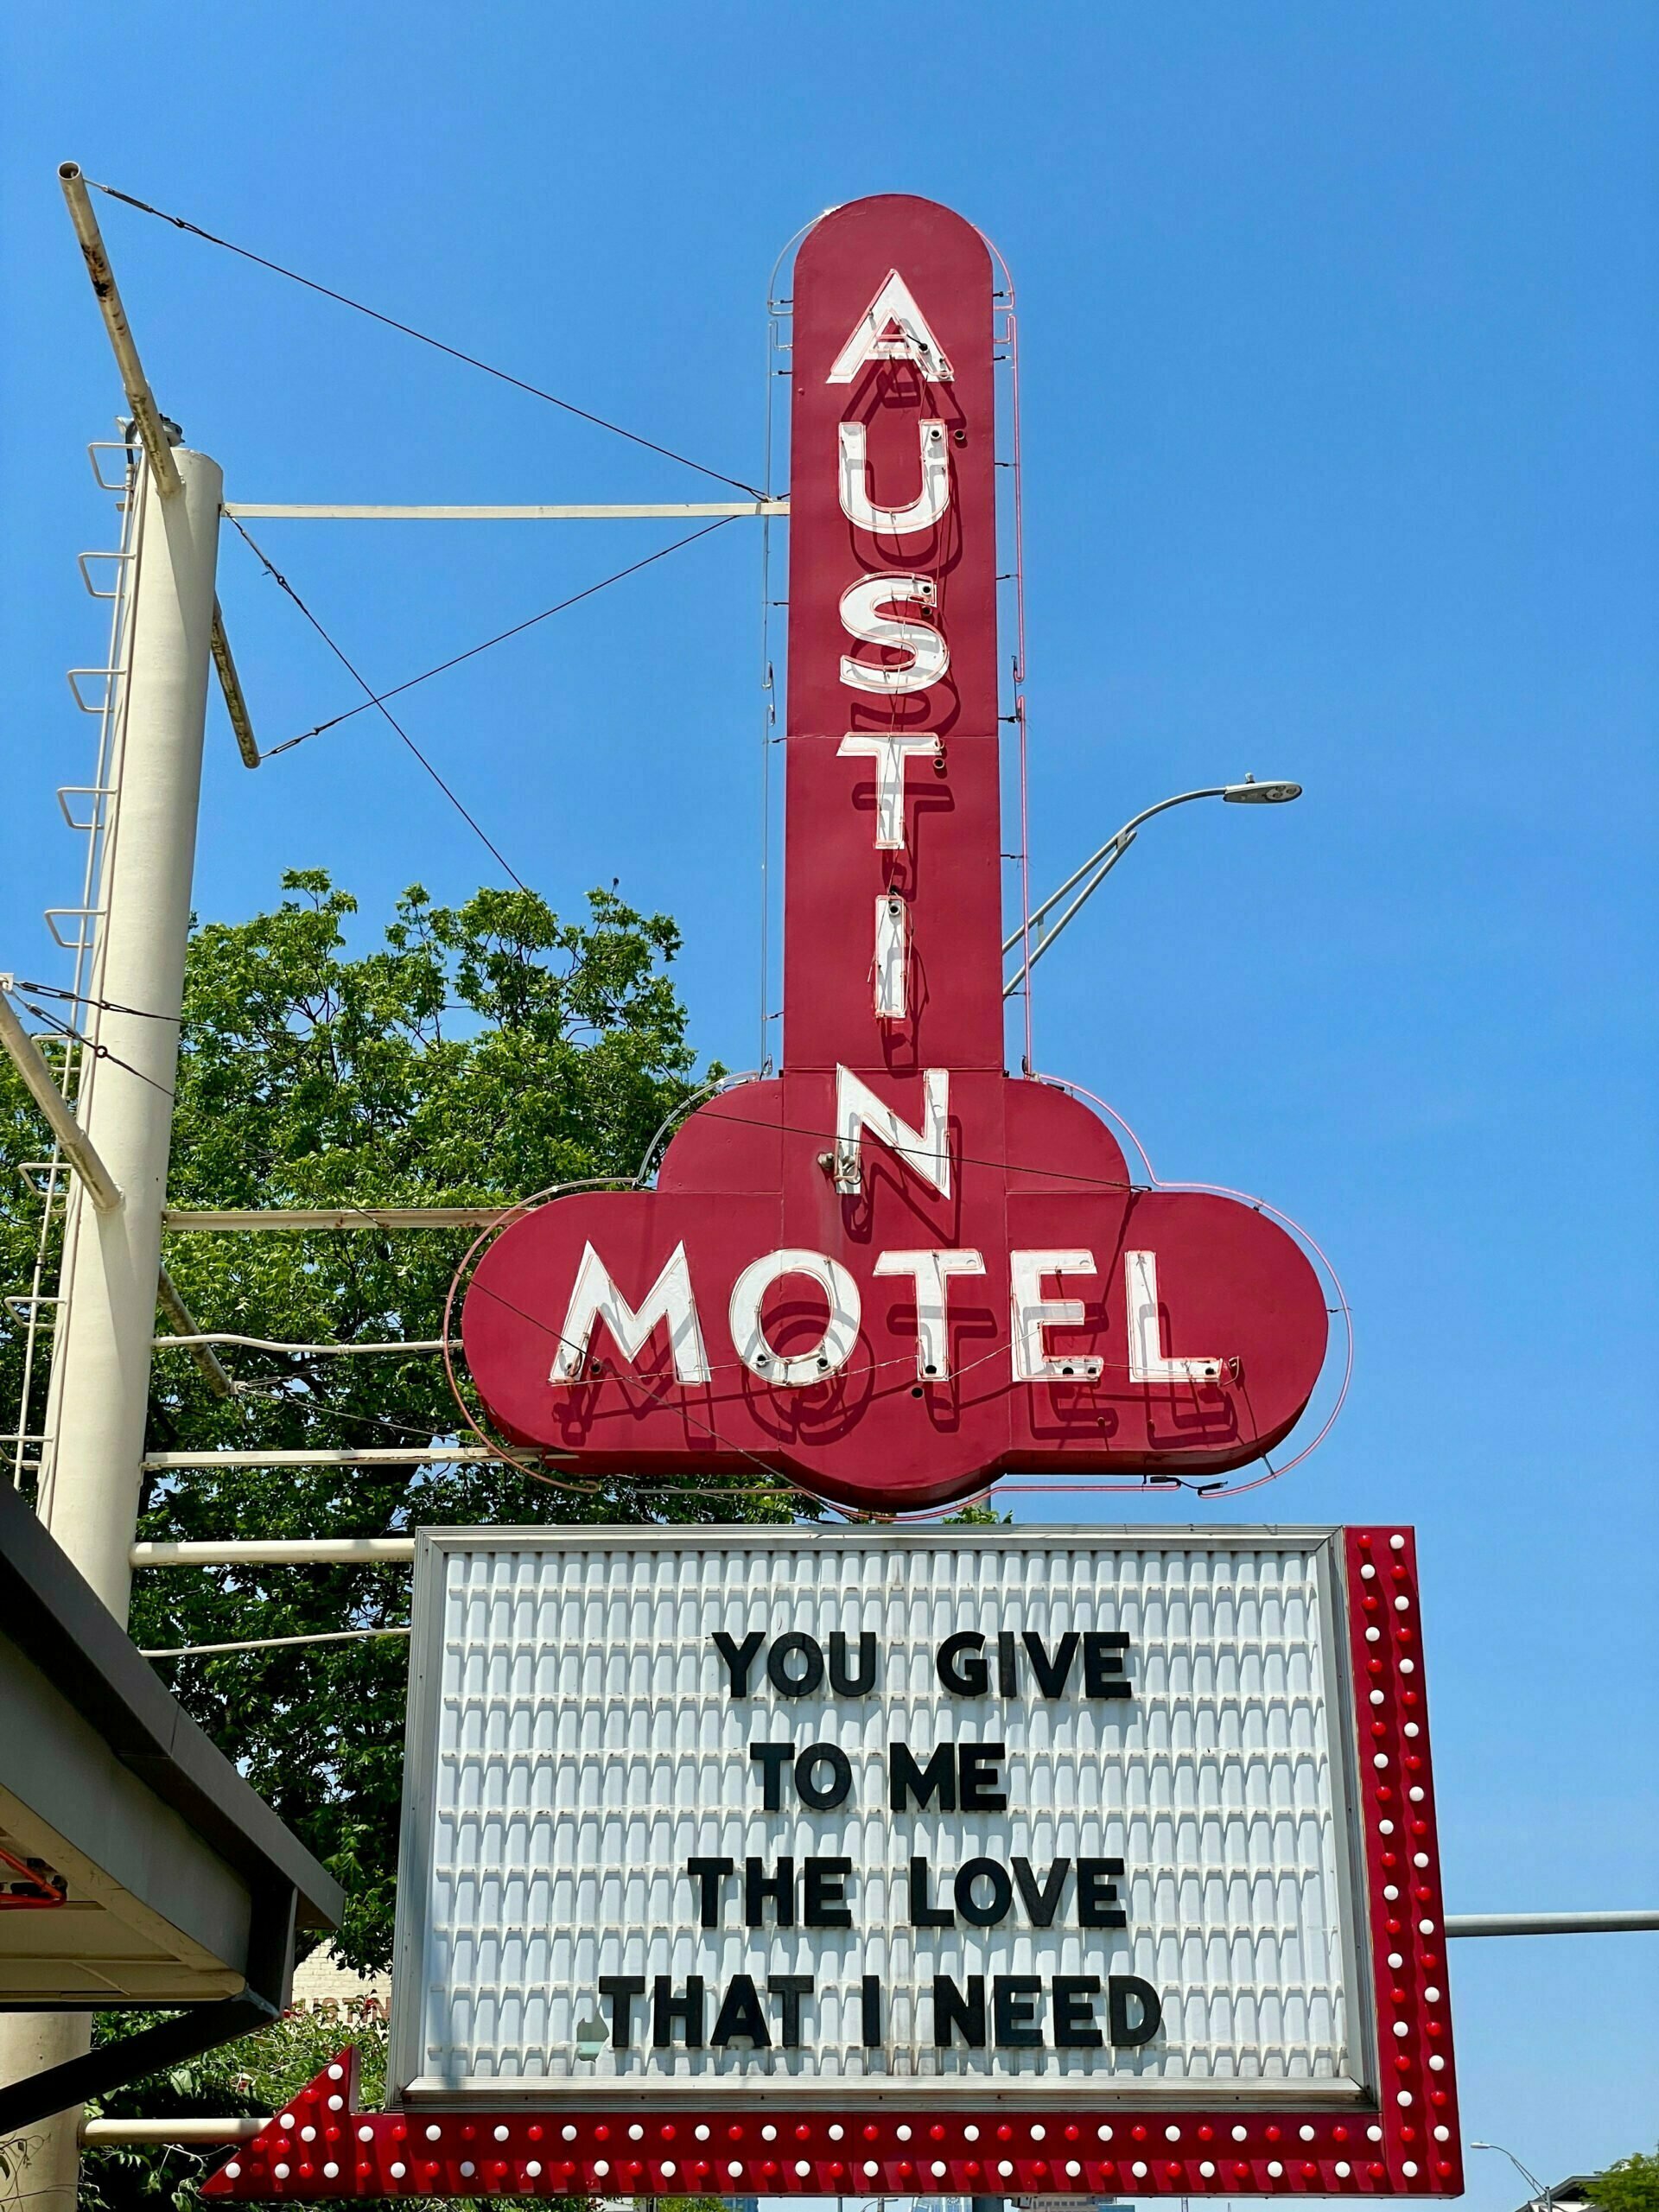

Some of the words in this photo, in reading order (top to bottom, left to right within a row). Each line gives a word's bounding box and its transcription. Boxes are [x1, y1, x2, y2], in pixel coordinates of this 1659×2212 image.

[827, 268, 956, 1199] AUSTIN
[549, 1239, 1225, 1386] MOTEL
[712, 1631, 876, 1700] YOU
[937, 1631, 1132, 1700] GIVE
[750, 1743, 852, 1814] TO
[890, 1743, 1007, 1814] ME
[688, 1857, 851, 1929] THE
[911, 1857, 1126, 1930] LOVE
[599, 1975, 814, 2051] THAT
[861, 1975, 881, 2050] I
[933, 1975, 1162, 2050] NEED
